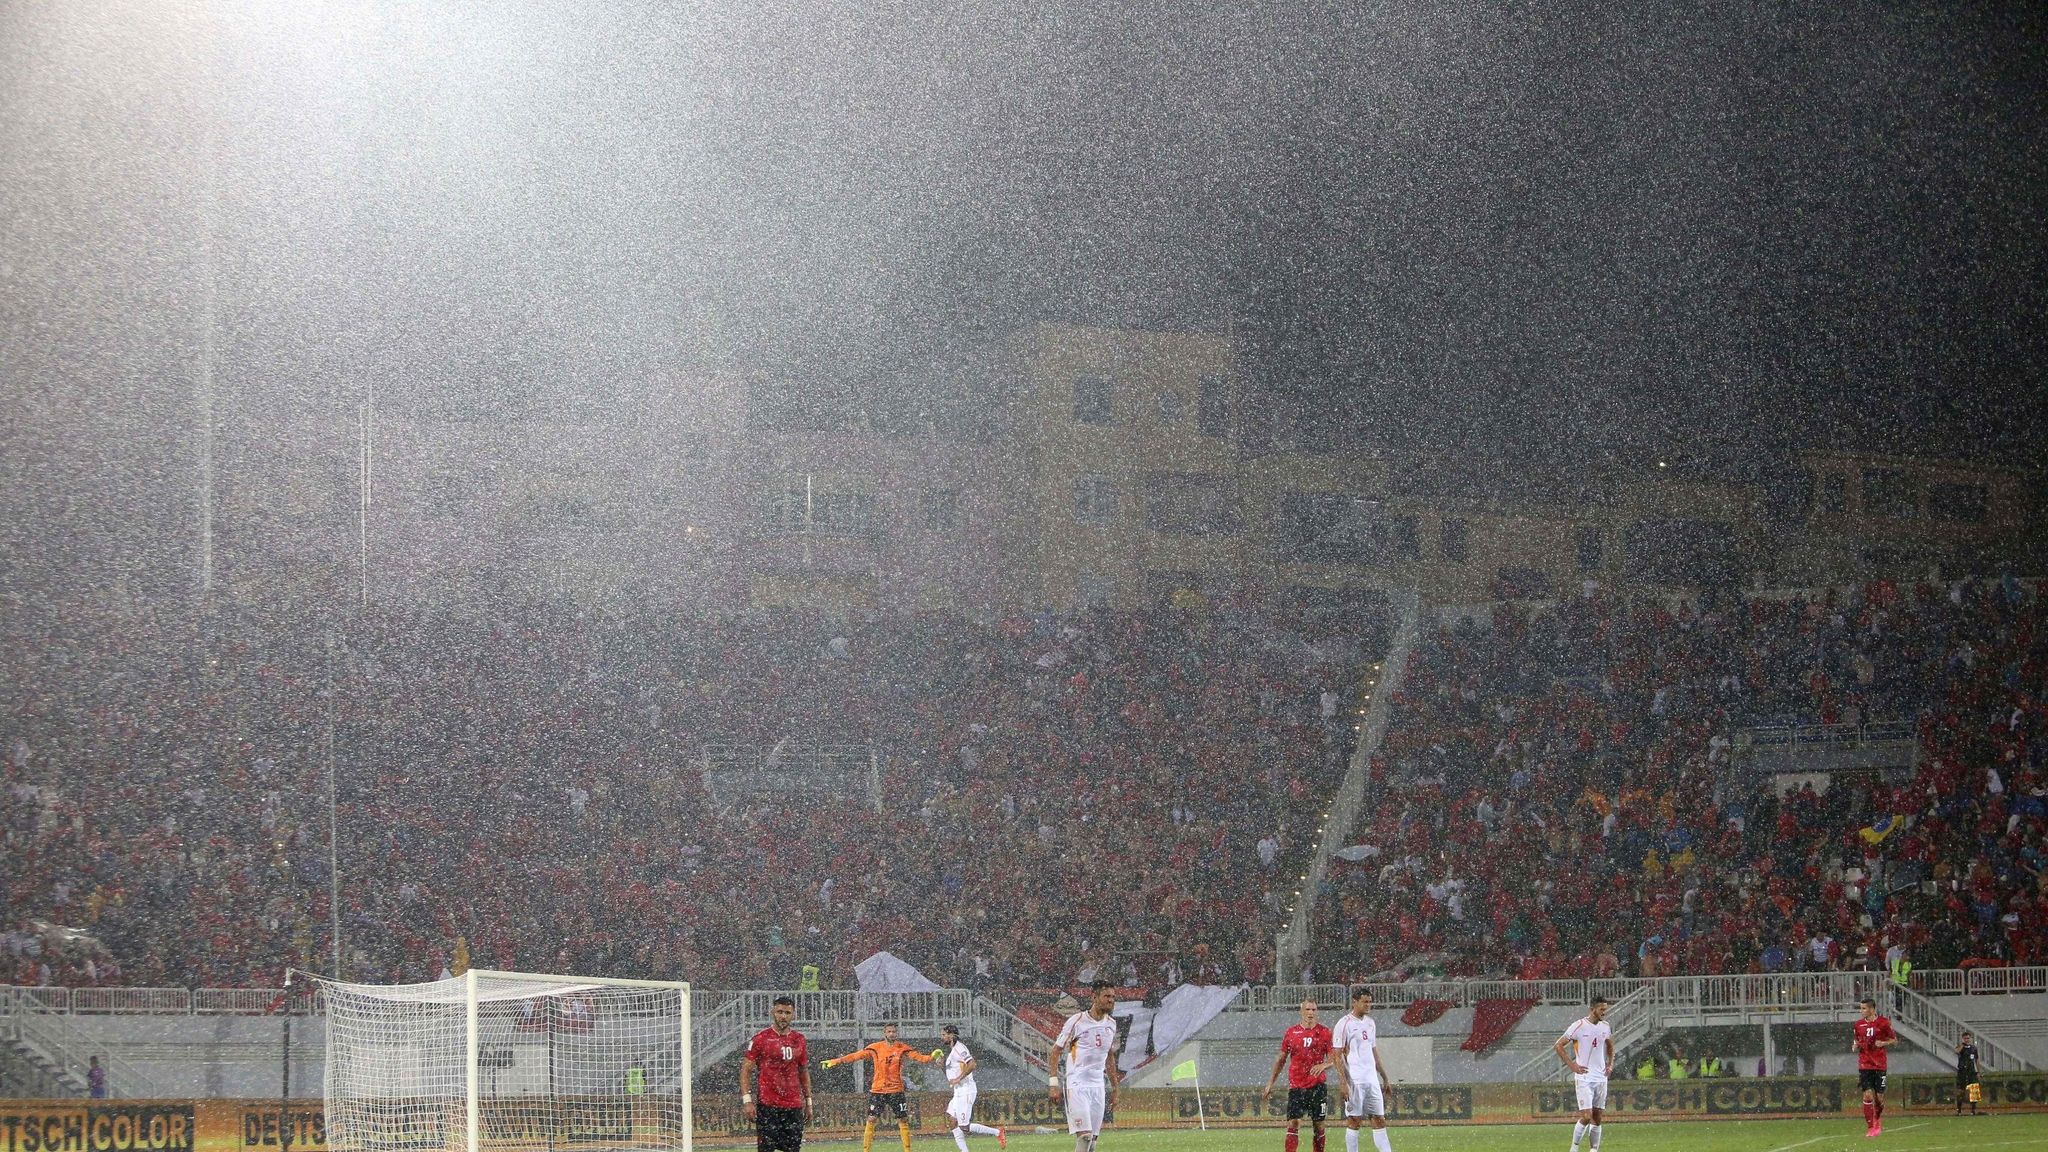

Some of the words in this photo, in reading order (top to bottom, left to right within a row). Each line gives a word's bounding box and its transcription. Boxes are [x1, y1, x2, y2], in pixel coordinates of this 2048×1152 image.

[1362, 1031, 1368, 1040] 6
[1866, 1027, 1874, 1037] 21
[1095, 1034, 1102, 1047] 5
[1303, 1037, 1313, 1048] 19
[781, 1046, 793, 1060] 10
[1539, 1087, 1700, 1113] DETSCH
[93, 1114, 188, 1150] COLOR
